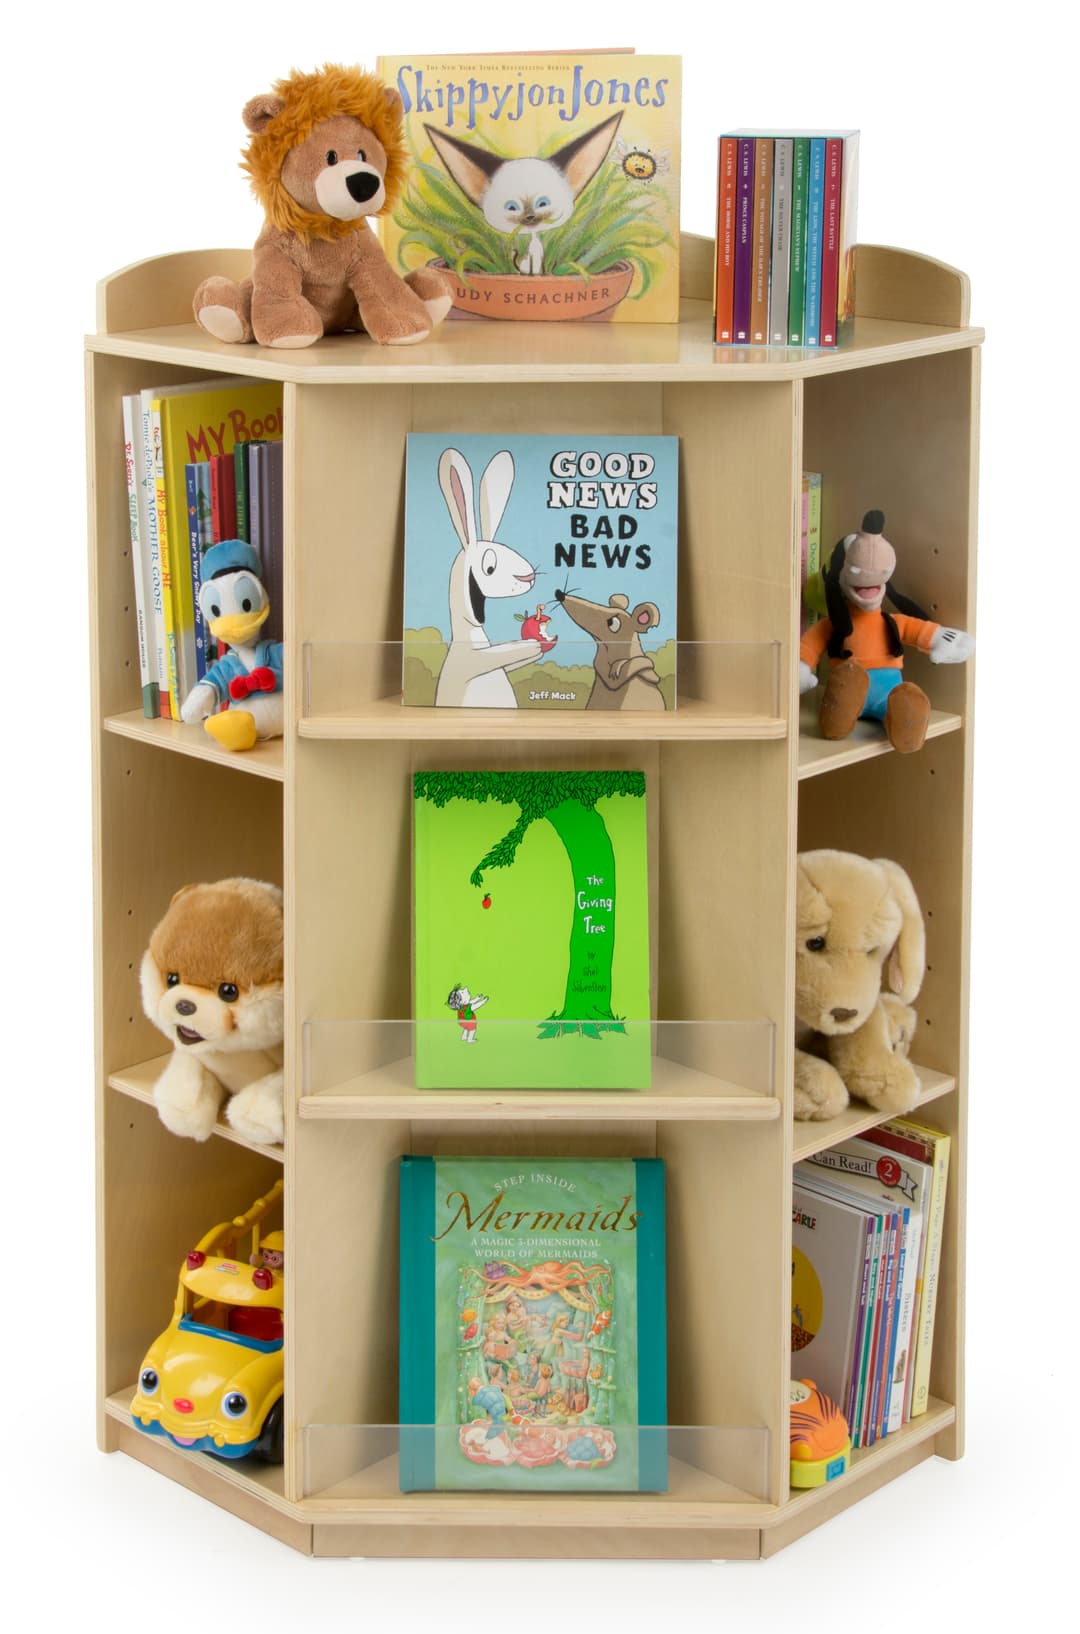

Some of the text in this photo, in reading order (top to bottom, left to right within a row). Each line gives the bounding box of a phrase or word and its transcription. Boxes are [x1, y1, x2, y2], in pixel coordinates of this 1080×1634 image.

[559, 65, 669, 121] Jones
[456, 287, 611, 304] UDY SCHACHNER
[550, 451, 655, 480] GOOD
[547, 482, 657, 510] NEWS
[570, 514, 638, 539] BAD
[147, 496, 162, 615] MOTHER GOOSE
[554, 543, 652, 569] NEWS
[192, 560, 200, 579] Very
[162, 572, 172, 589] ME
[529, 691, 576, 701] Jeff Mack
[586, 875, 604, 886] The
[577, 891, 613, 912] Giving
[583, 915, 606, 934] Tree
[812, 1154, 873, 1174] Can Read!
[884, 1163, 894, 1178] 2
[494, 1173, 577, 1193] STEP INSIDE
[430, 1191, 644, 1242] Mermaids
[471, 1238, 601, 1247] A MAGIC 3-DIMENSIONAL
[475, 1250, 598, 1258] WORLD OF MERMAIDS
